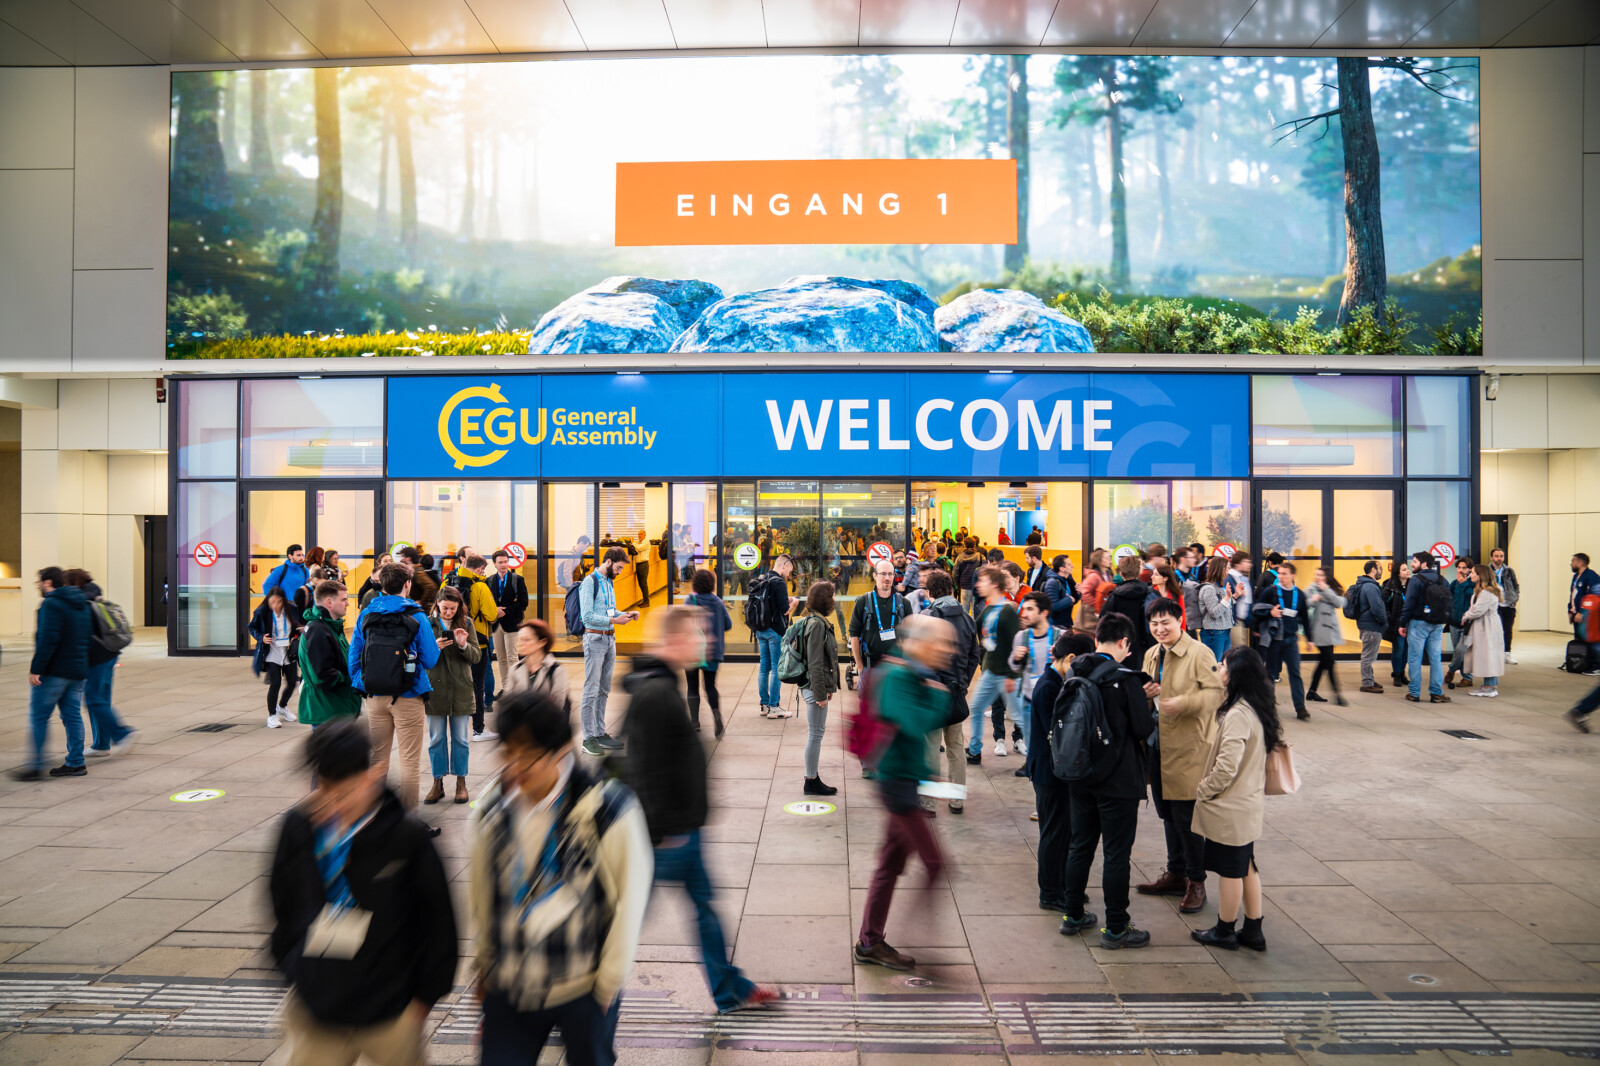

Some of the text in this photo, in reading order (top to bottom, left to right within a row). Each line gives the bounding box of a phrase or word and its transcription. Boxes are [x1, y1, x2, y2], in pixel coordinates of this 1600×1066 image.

[677, 192, 947, 217] EINGANG 1
[460, 407, 637, 445] EGU General
[551, 427, 658, 450] Assembly
[766, 398, 1113, 451] WELCOME
